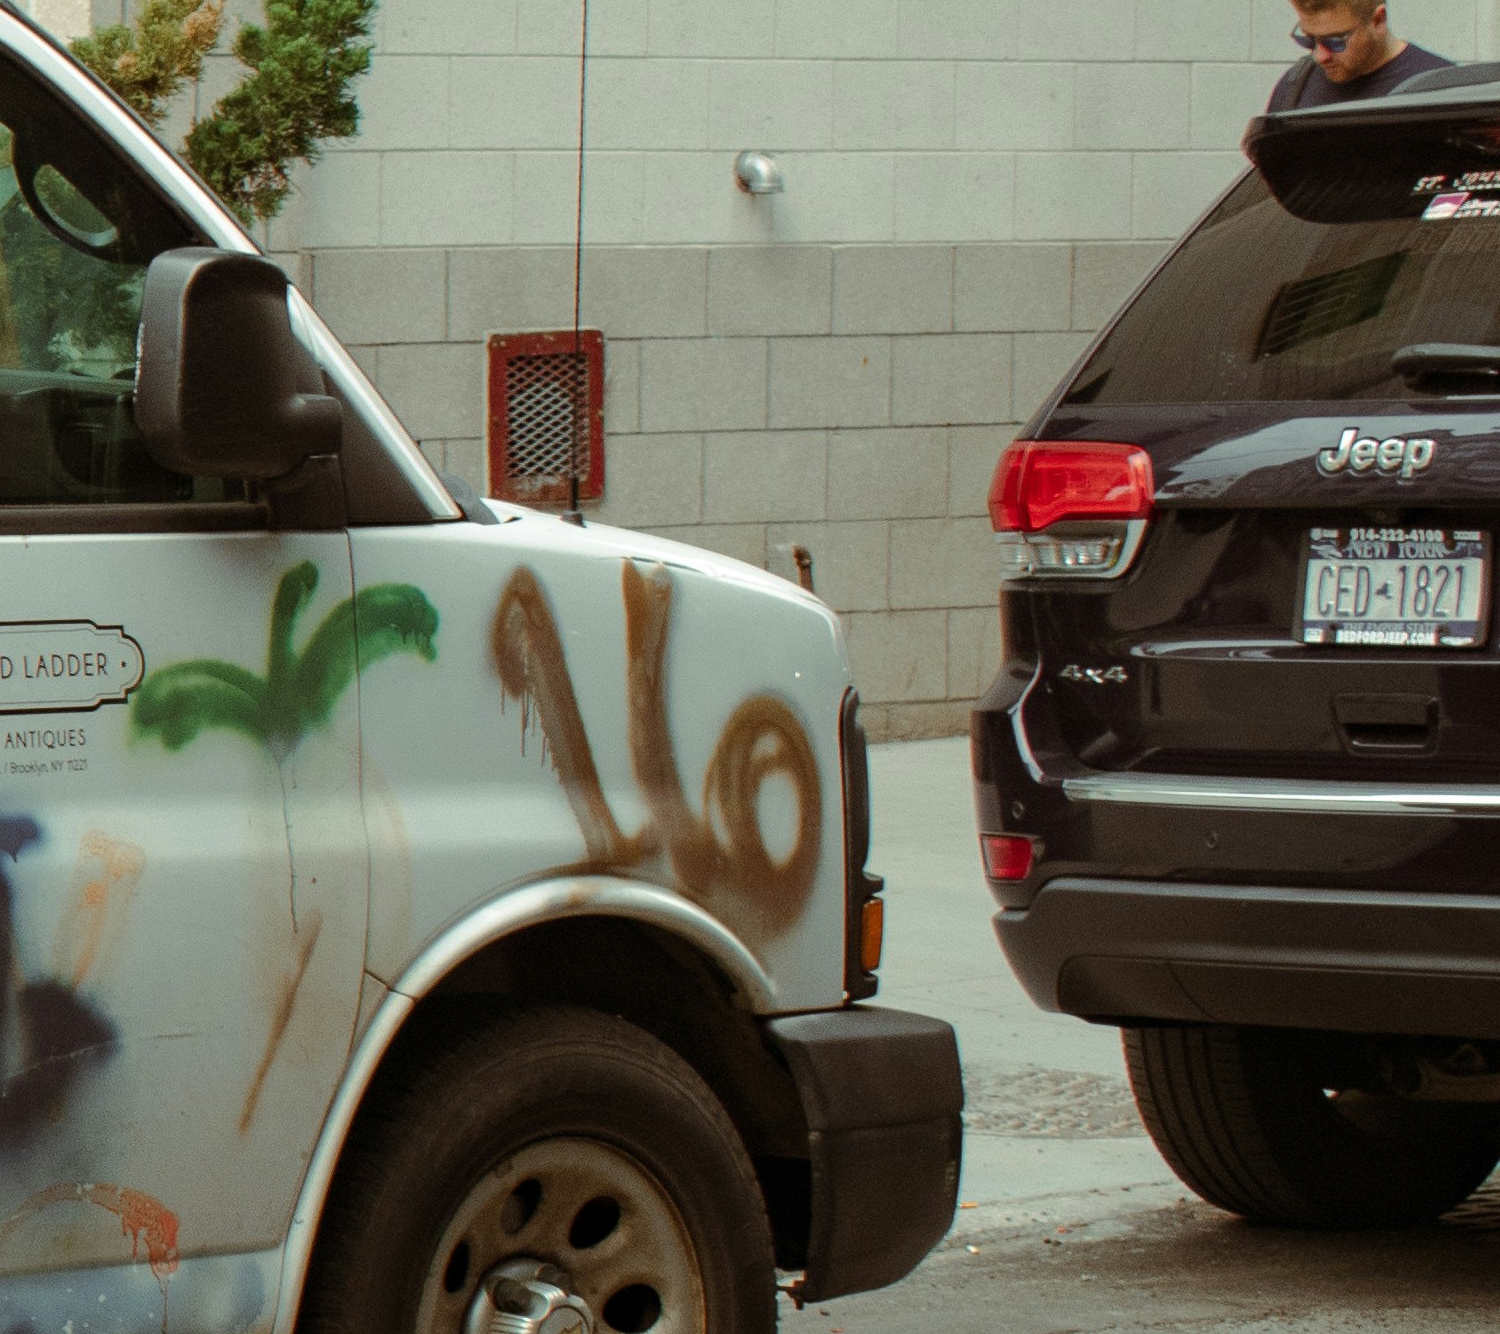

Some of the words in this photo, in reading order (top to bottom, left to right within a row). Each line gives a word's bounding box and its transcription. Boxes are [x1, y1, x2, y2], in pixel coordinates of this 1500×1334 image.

[1318, 425, 1438, 480] Jeep
[1347, 540, 1391, 559] NEW
[1397, 540, 1446, 559] YORK
[1398, 564, 1465, 618] 1821
[1336, 629, 1437, 645] BEDFORDJEEP.COM
[22, 652, 108, 679] LADDER
[4, 728, 87, 750] ANTIQUES
[50, 760, 64, 772] NY
